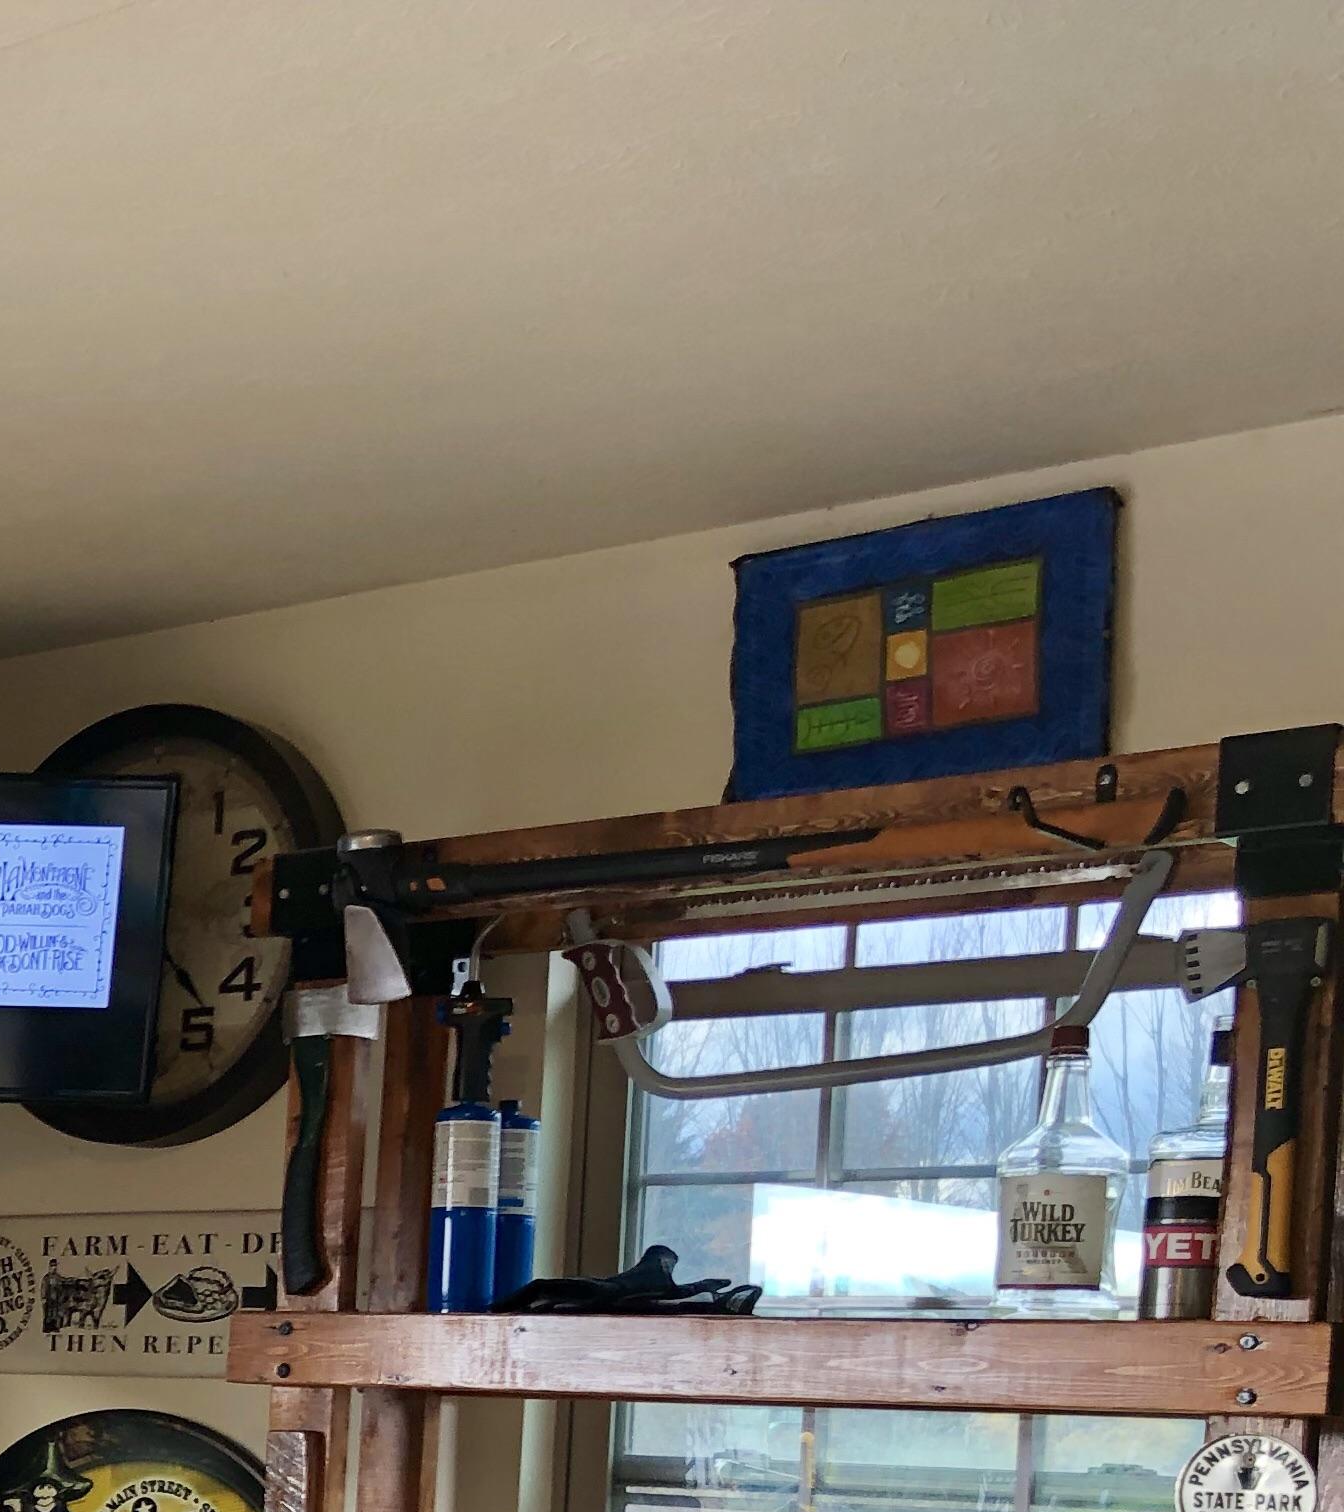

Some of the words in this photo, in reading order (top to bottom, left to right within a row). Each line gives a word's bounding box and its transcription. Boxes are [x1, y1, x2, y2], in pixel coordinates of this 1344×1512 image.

[231, 830, 267, 875] 2
[219, 957, 261, 1001] 4
[181, 1007, 214, 1052] 5
[1022, 1201, 1075, 1222] WILD
[42, 1234, 129, 1257] FARM
[151, 1233, 219, 1256] EAT
[1010, 1218, 1086, 1244] TURKEY
[48, 1333, 127, 1353] THEN
[1188, 1438, 1310, 1491] PENNSYLVANIA
[105, 1484, 138, 1512] MAIN
[140, 1479, 193, 1502] STREET
[1192, 1491, 1245, 1510] STATE
[1255, 1493, 1303, 1512] PARK
